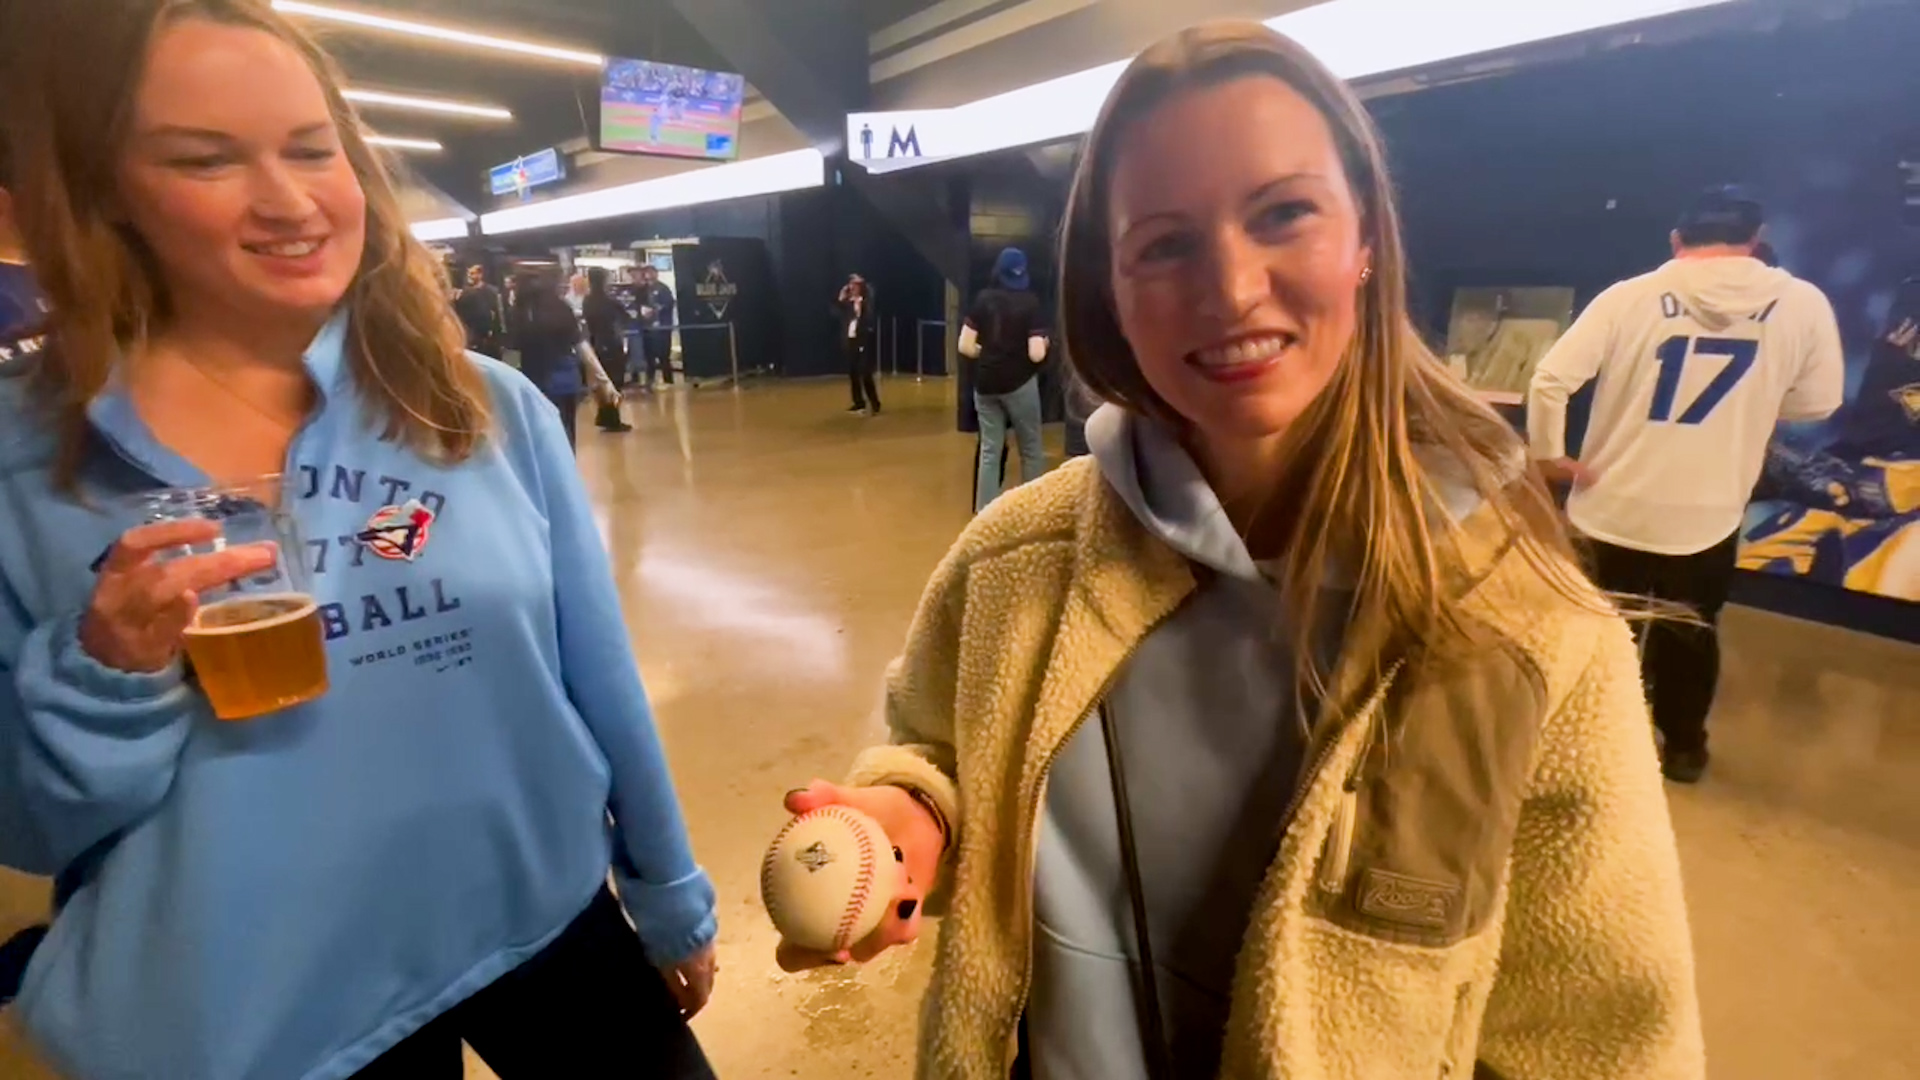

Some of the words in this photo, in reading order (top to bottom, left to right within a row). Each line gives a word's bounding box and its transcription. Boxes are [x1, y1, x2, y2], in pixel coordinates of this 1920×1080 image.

[887, 124, 922, 158] M
[1647, 335, 1759, 424] 17
[300, 464, 446, 523] ONTO
[317, 578, 461, 641] BALL
[349, 645, 406, 667] WORLD
